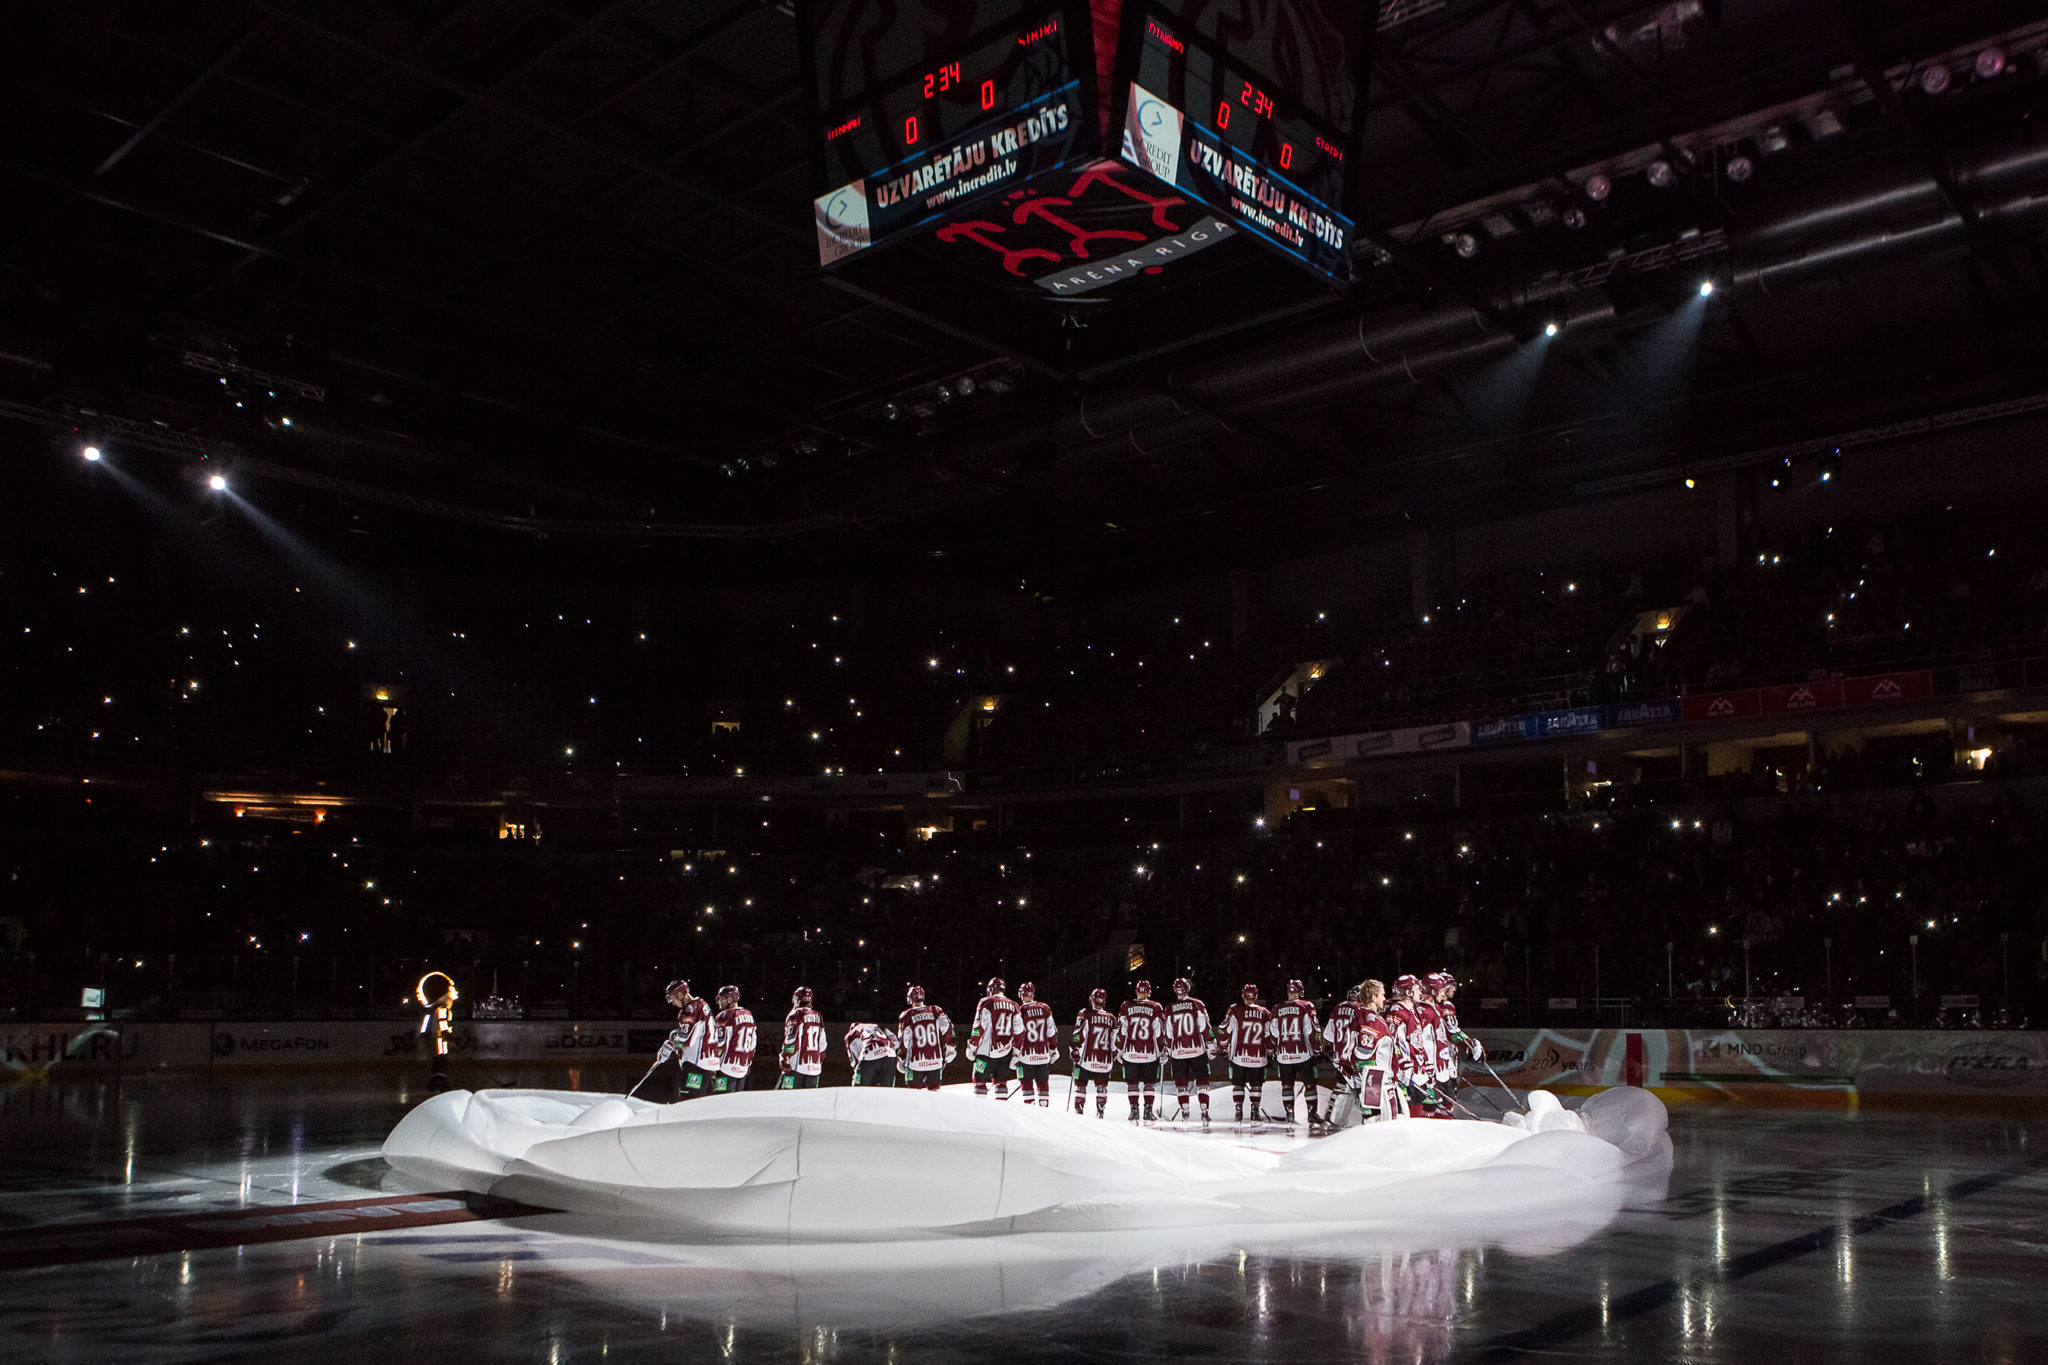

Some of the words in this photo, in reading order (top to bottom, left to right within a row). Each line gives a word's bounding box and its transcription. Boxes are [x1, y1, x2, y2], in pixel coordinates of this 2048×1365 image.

[981, 80, 995, 111] 0
[1217, 101, 1231, 130] 0
[905, 116, 918, 145] 0
[877, 140, 986, 209] UZVARĒTĀJU
[991, 103, 1069, 158] KREDĪTS
[1280, 142, 1293, 170] 0
[926, 159, 1018, 209] www.incredit.lv
[1231, 196, 1304, 248] www.incredit.lv
[1288, 199, 1344, 250] KREDĪTS
[1053, 257, 1143, 291] ARENA
[1155, 221, 1229, 256] RIGA
[914, 1022, 938, 1048] 96
[995, 1012, 1013, 1036] 41
[1026, 1018, 1045, 1043] 87
[1129, 1016, 1150, 1041] 73
[1173, 1013, 1194, 1037] 70
[1242, 1020, 1263, 1045] 72
[1281, 1018, 1300, 1041] 44
[241, 1037, 329, 1051] MEGAFON
[545, 1035, 624, 1048] SOGAZ
[806, 1026, 820, 1051] 17
[1092, 1026, 1110, 1050] 74
[1727, 1043, 1763, 1056] MND
[1766, 1043, 1808, 1059] Group
[1561, 1061, 1597, 1073] years
